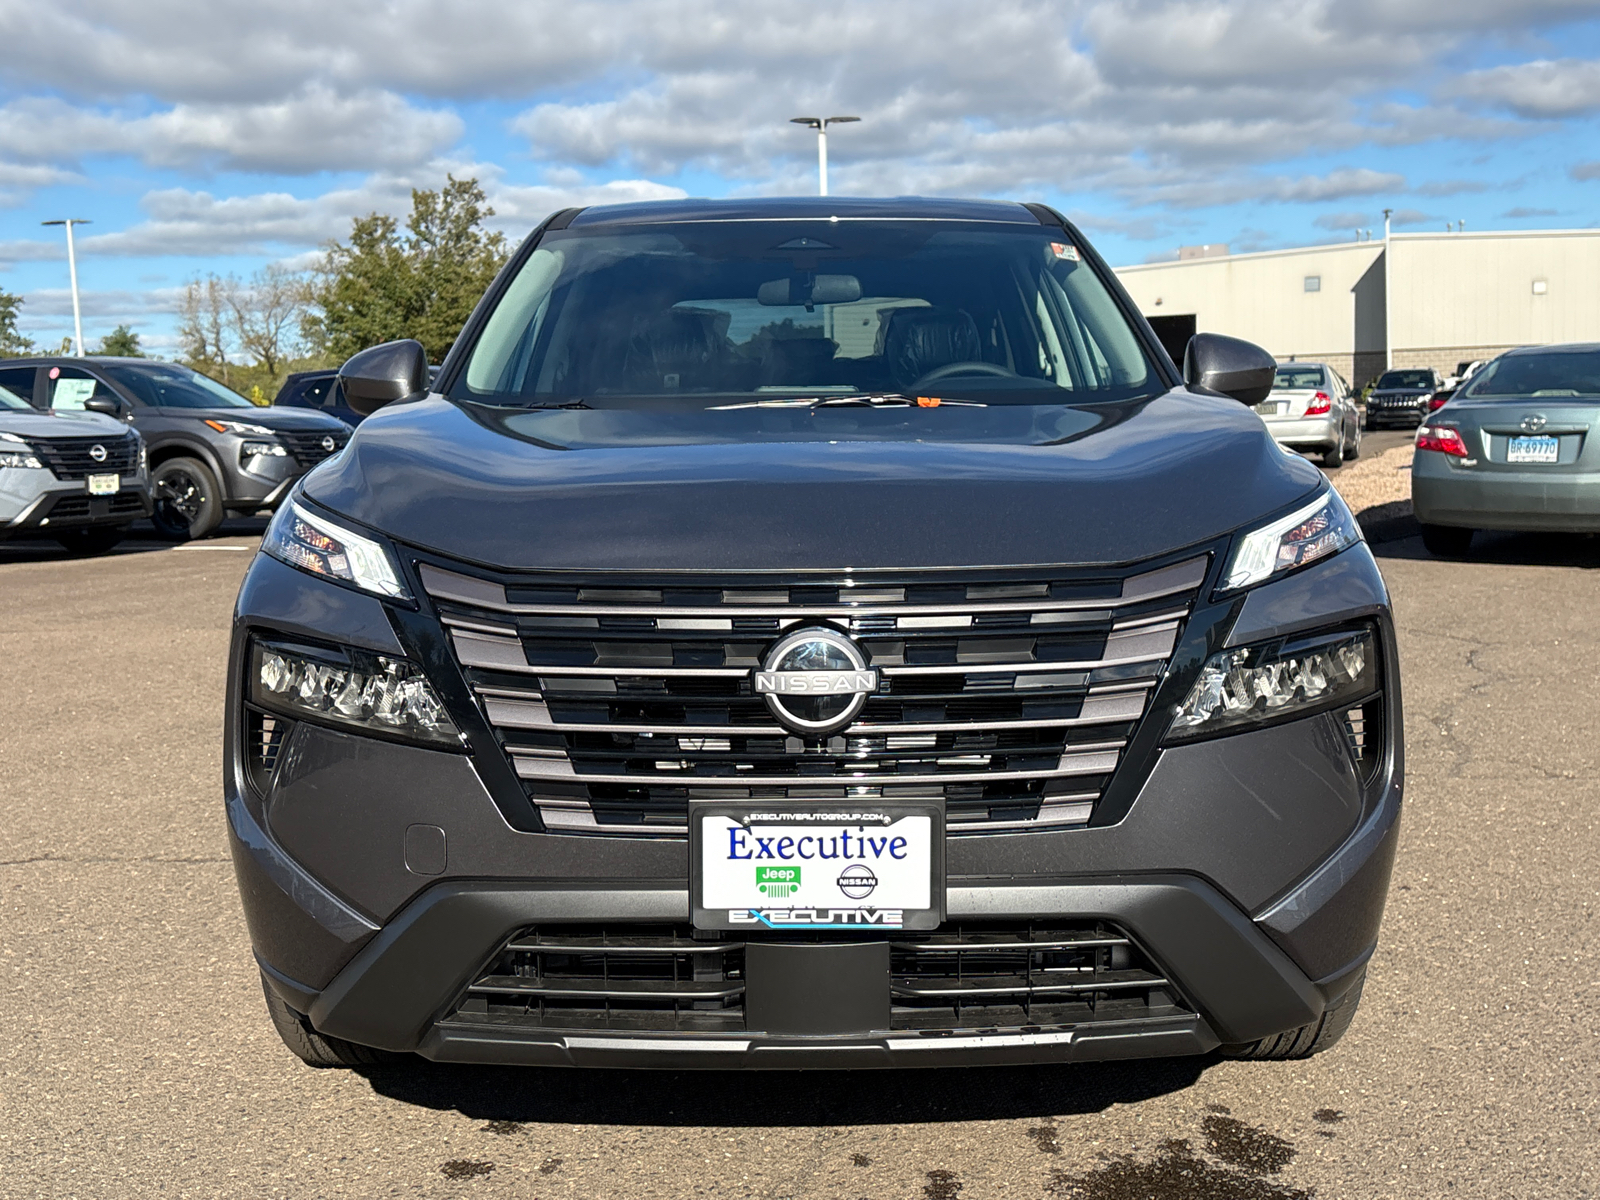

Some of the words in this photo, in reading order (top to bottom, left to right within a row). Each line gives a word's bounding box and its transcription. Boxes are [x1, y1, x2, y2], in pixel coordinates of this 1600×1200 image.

[757, 674, 874, 691] NISSAN
[750, 813, 884, 821] EXECUTIVEAUTOGROUP.COM
[727, 826, 908, 860] Executive
[762, 868, 795, 882] Jeep
[839, 878, 876, 886] NISSAN
[728, 909, 903, 924] EXECUTIVE
